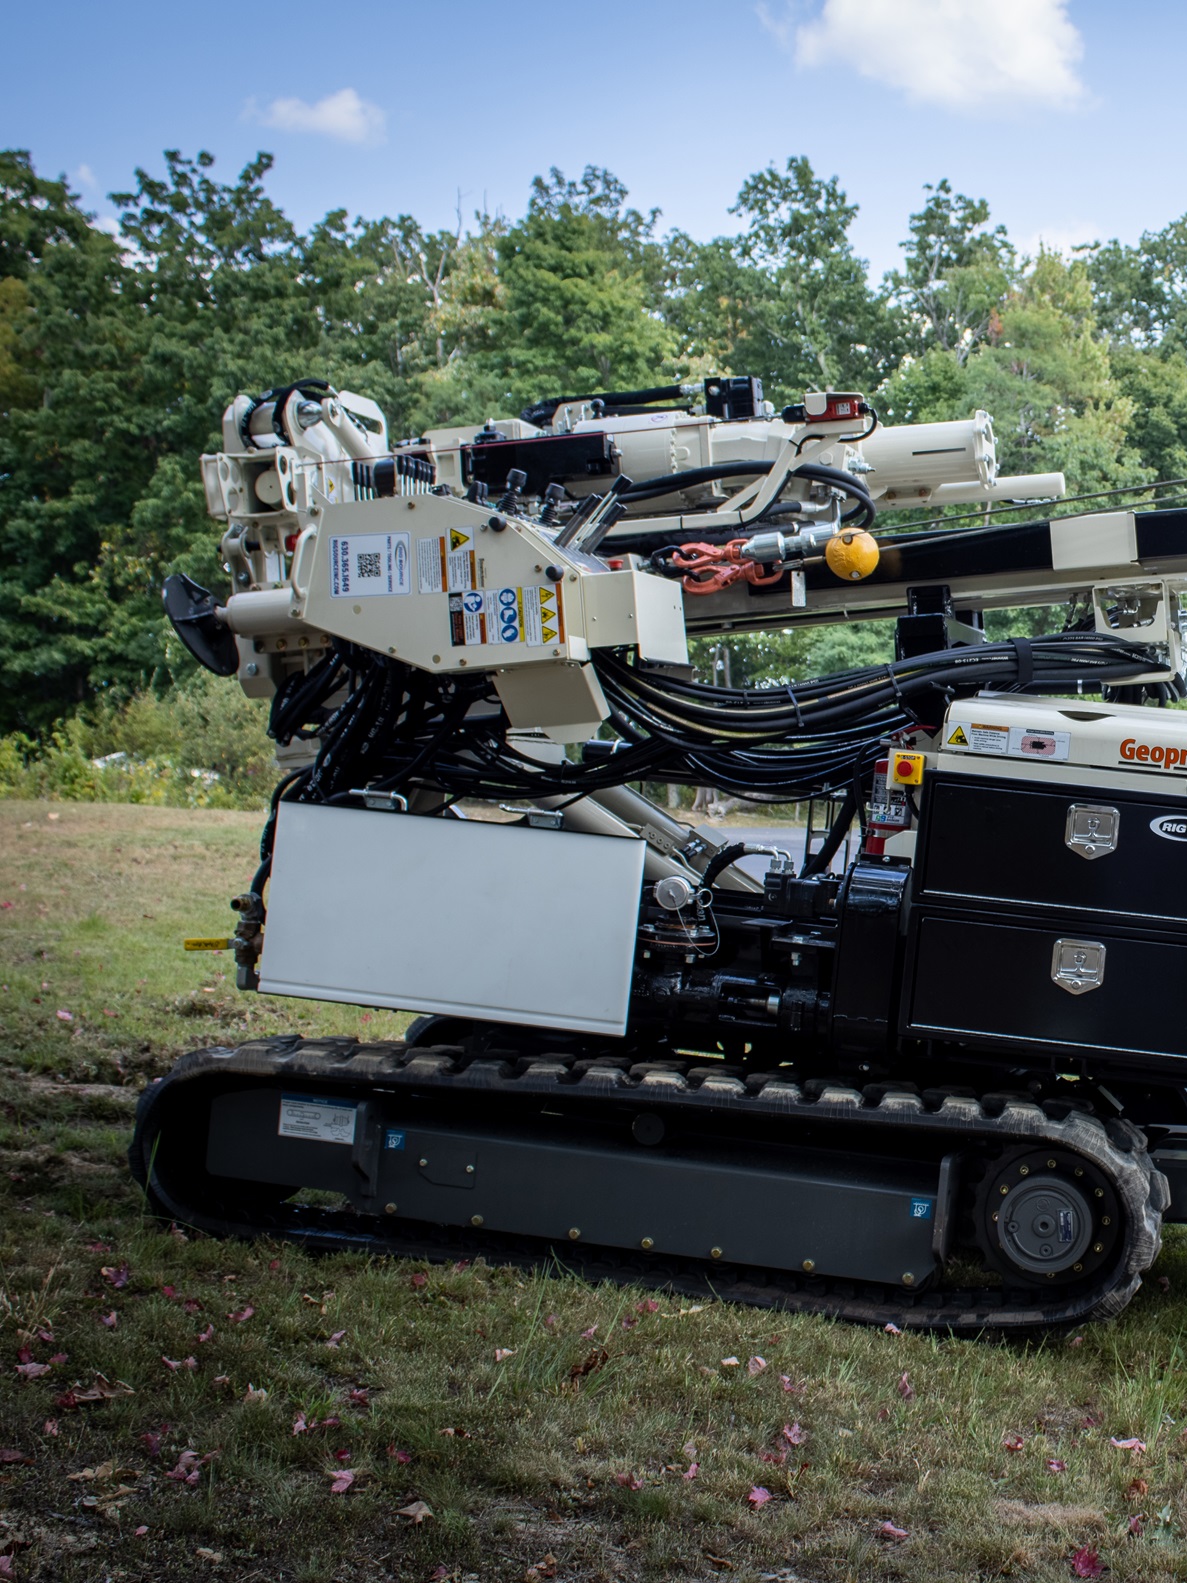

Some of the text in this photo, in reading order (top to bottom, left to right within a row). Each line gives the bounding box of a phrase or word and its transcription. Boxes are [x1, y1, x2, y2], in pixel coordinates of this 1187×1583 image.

[332, 539, 340, 595] RIGSOURCEINC.COM
[340, 541, 350, 593] 630.365.1649
[1161, 821, 1187, 834] RIG
